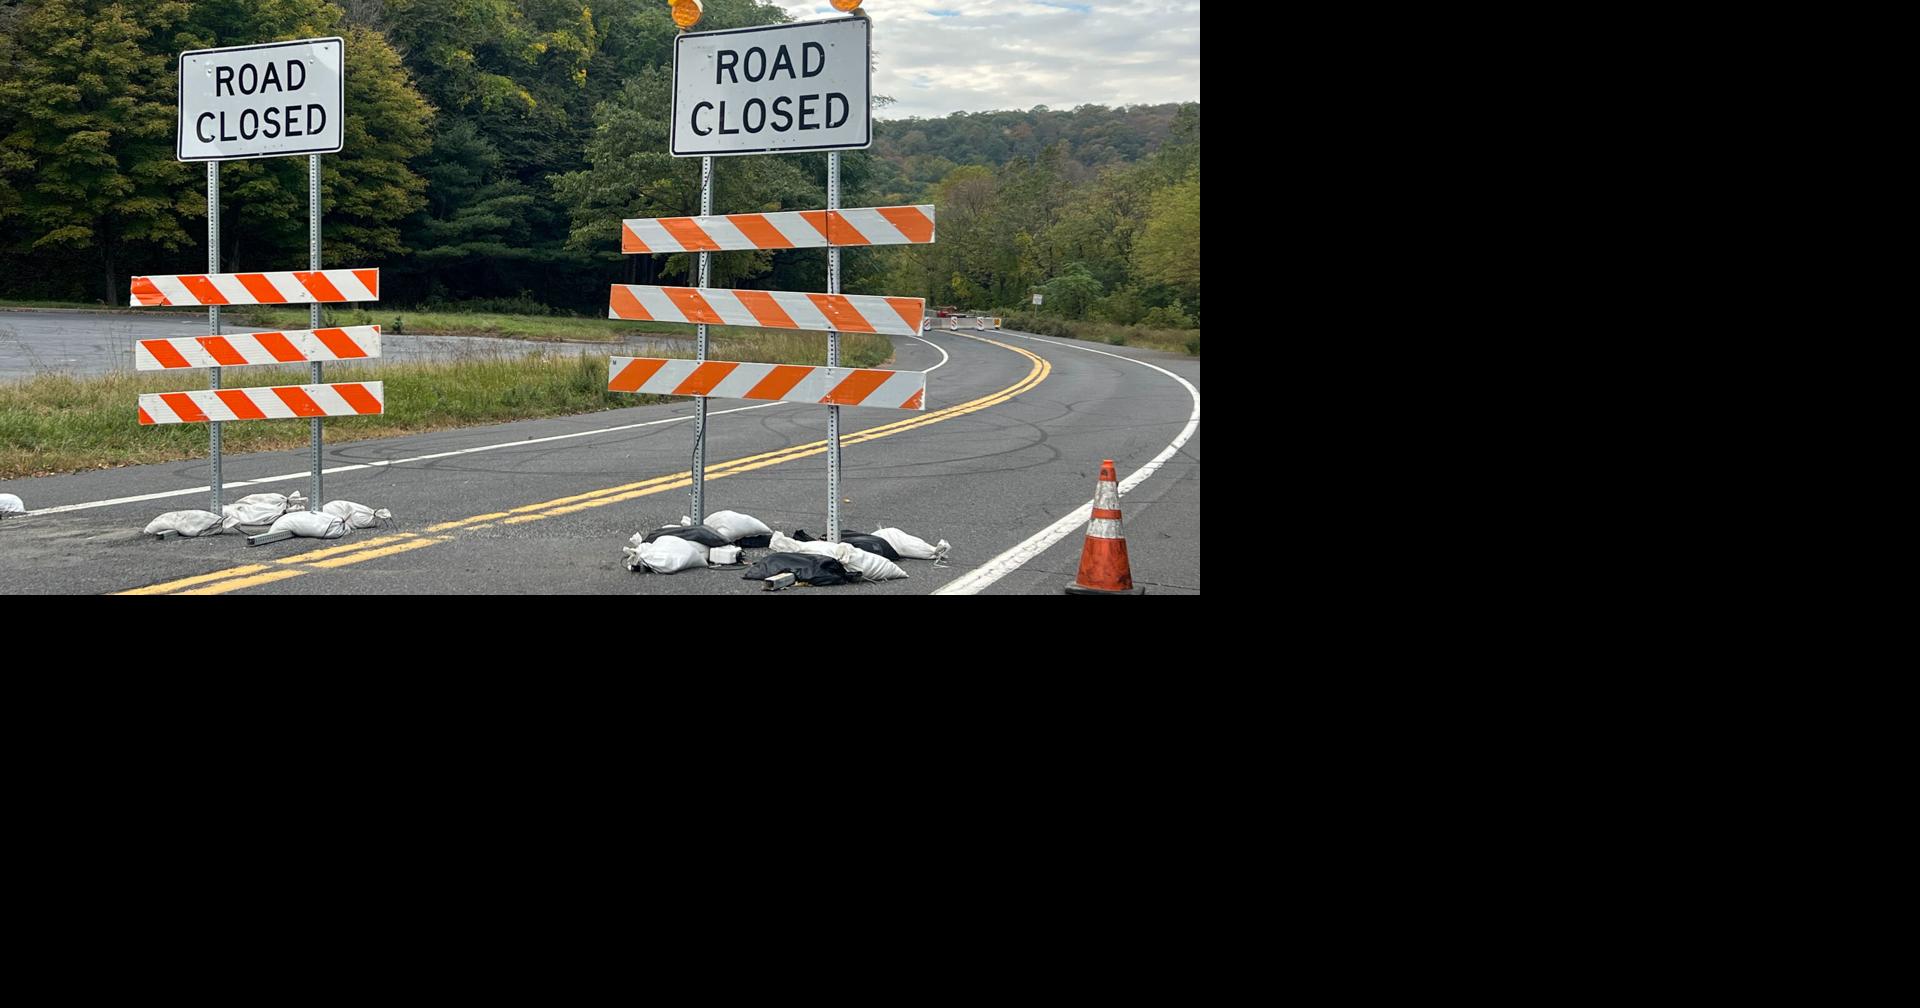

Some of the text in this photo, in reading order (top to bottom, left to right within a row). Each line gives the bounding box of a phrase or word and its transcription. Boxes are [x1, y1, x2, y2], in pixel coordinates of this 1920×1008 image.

[216, 60, 306, 97] ROAD
[716, 42, 825, 84] ROAD
[197, 104, 326, 143] CLOSED
[691, 93, 850, 136] CLOSED
